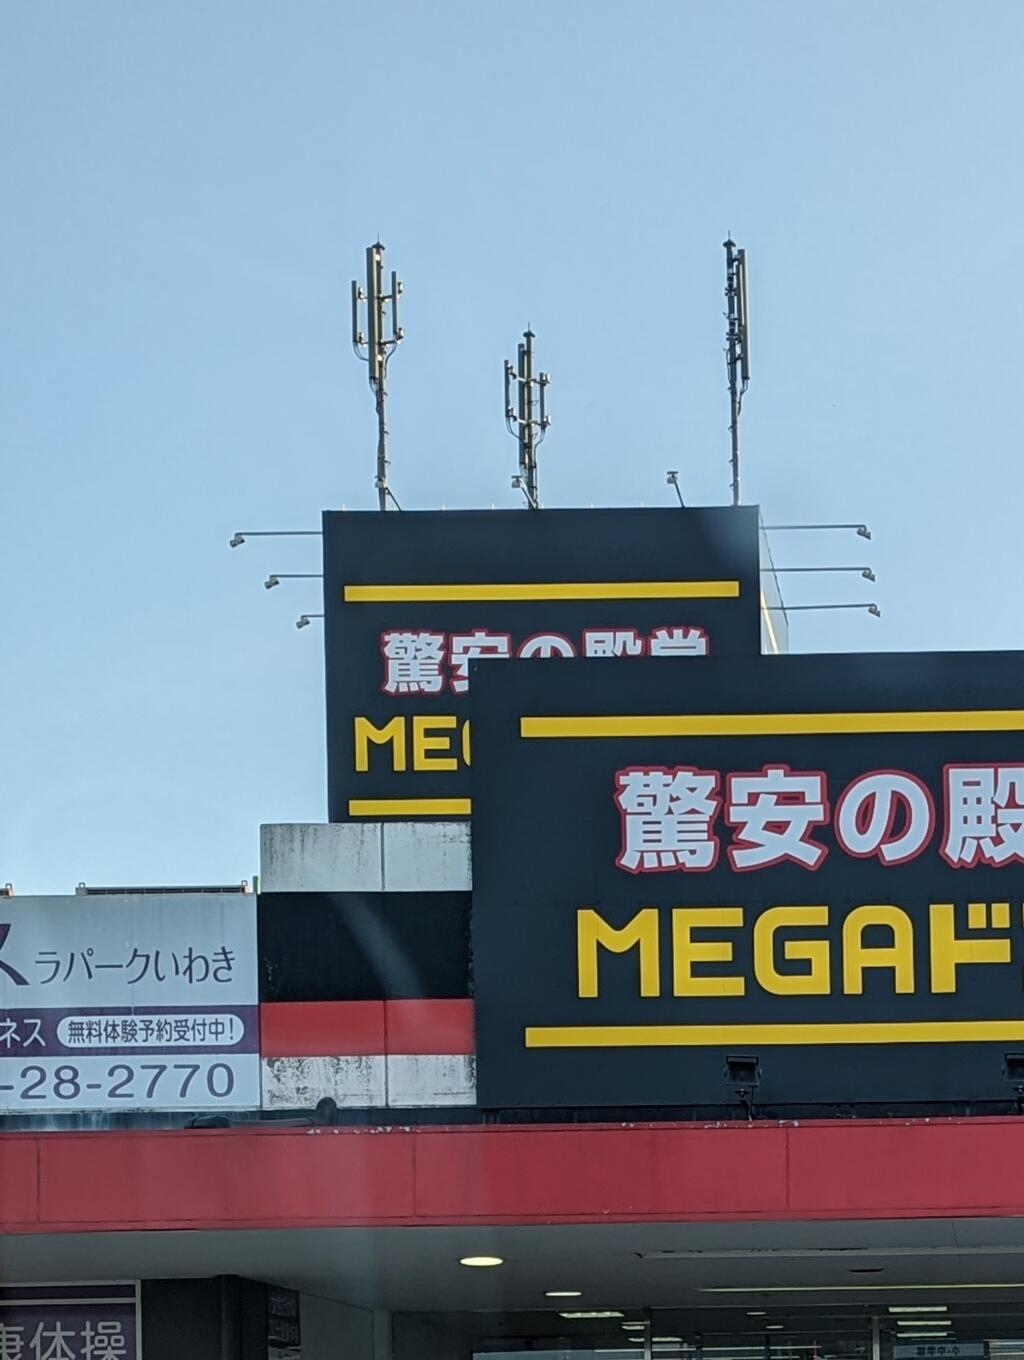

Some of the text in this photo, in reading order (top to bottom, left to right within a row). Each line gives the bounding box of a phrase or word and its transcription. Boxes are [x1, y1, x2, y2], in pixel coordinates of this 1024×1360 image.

[354, 715, 471, 772] ME
[35, 946, 236, 985] ラパークいわき
